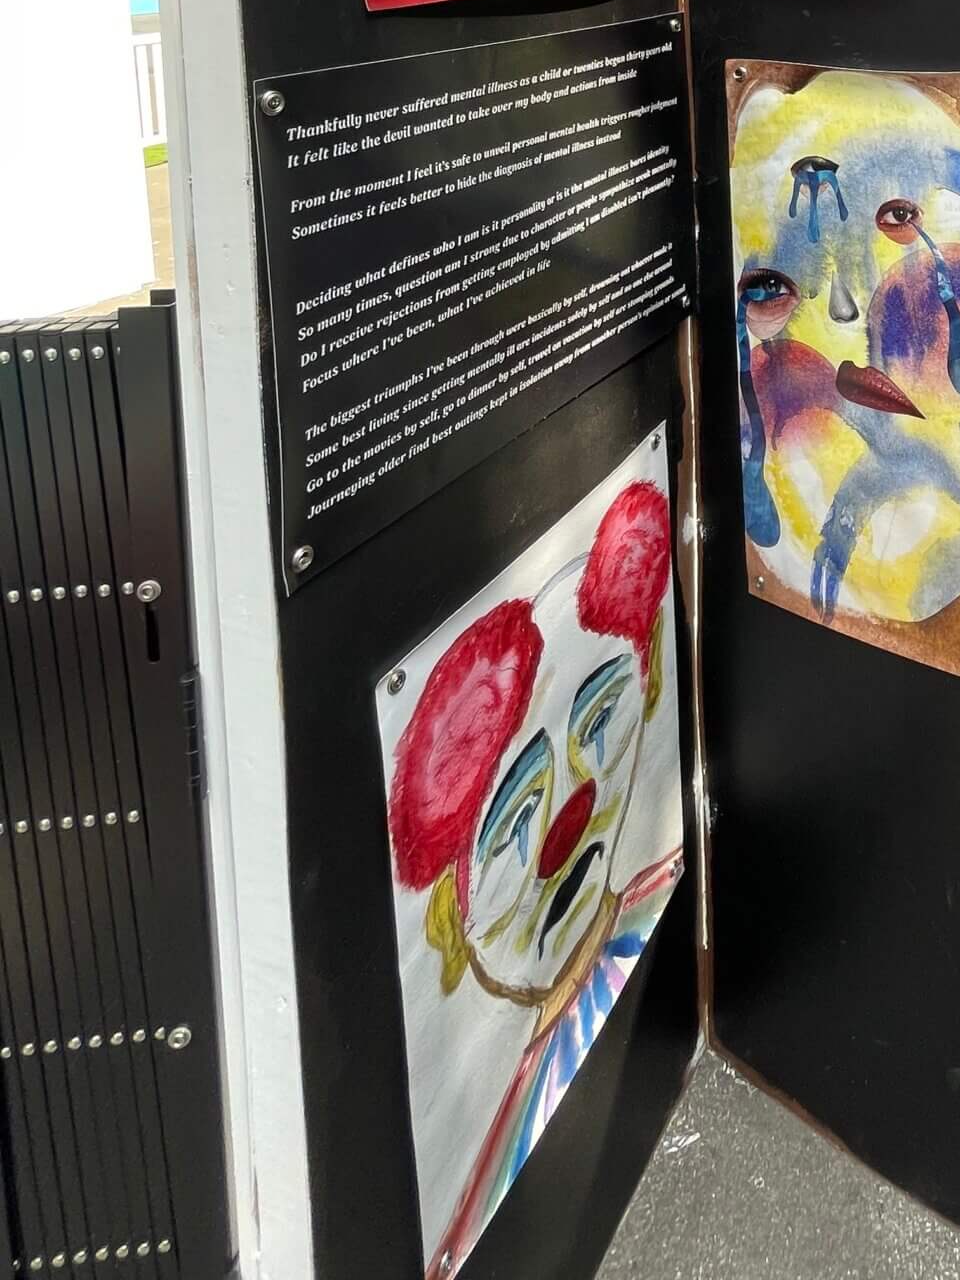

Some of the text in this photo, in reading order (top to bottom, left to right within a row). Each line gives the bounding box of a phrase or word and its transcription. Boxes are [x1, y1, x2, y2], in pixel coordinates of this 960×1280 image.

[286, 77, 531, 142] Thankfully never suffered mental illness as
[288, 114, 454, 169] It felt like the devil wanted
[291, 160, 450, 214] From the moment I feel it's
[291, 175, 477, 240] Sometimes it feels better to hide
[296, 235, 462, 316] Deciding what defines who I
[298, 255, 468, 341] So many times, question am I
[301, 282, 460, 368] Do I receive rejections from
[303, 302, 464, 393] Focus where I've been, what
[305, 350, 469, 441] The biggest triumphs I've been
[305, 373, 466, 467] Some best living since getting
[306, 423, 417, 493] Go to the movies by
[307, 405, 489, 520] Journeying older find best outings
